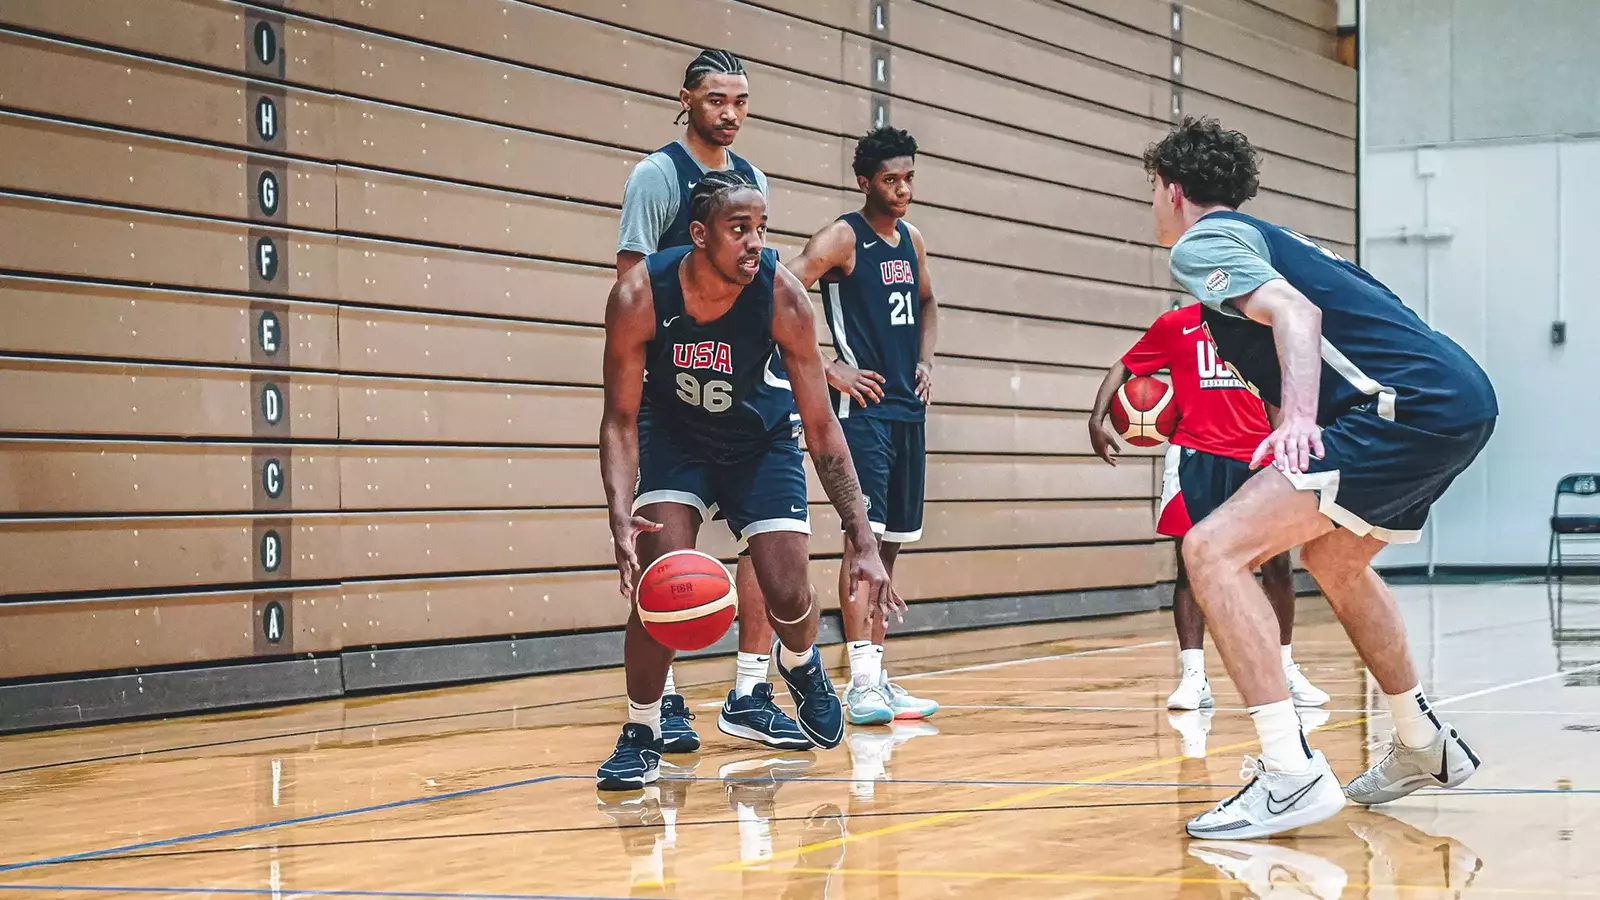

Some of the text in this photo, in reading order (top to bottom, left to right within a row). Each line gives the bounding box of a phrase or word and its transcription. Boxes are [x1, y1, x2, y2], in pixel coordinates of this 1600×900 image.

[261, 103, 273, 136] H
[262, 177, 274, 209] G
[260, 244, 273, 276] F
[880, 259, 915, 285] USA
[888, 291, 915, 325] 21
[262, 318, 276, 352] E
[673, 341, 733, 374] USA
[266, 389, 278, 421] D
[676, 372, 733, 413] 96
[267, 462, 279, 493] C
[266, 536, 277, 568] B
[268, 607, 280, 639] A
